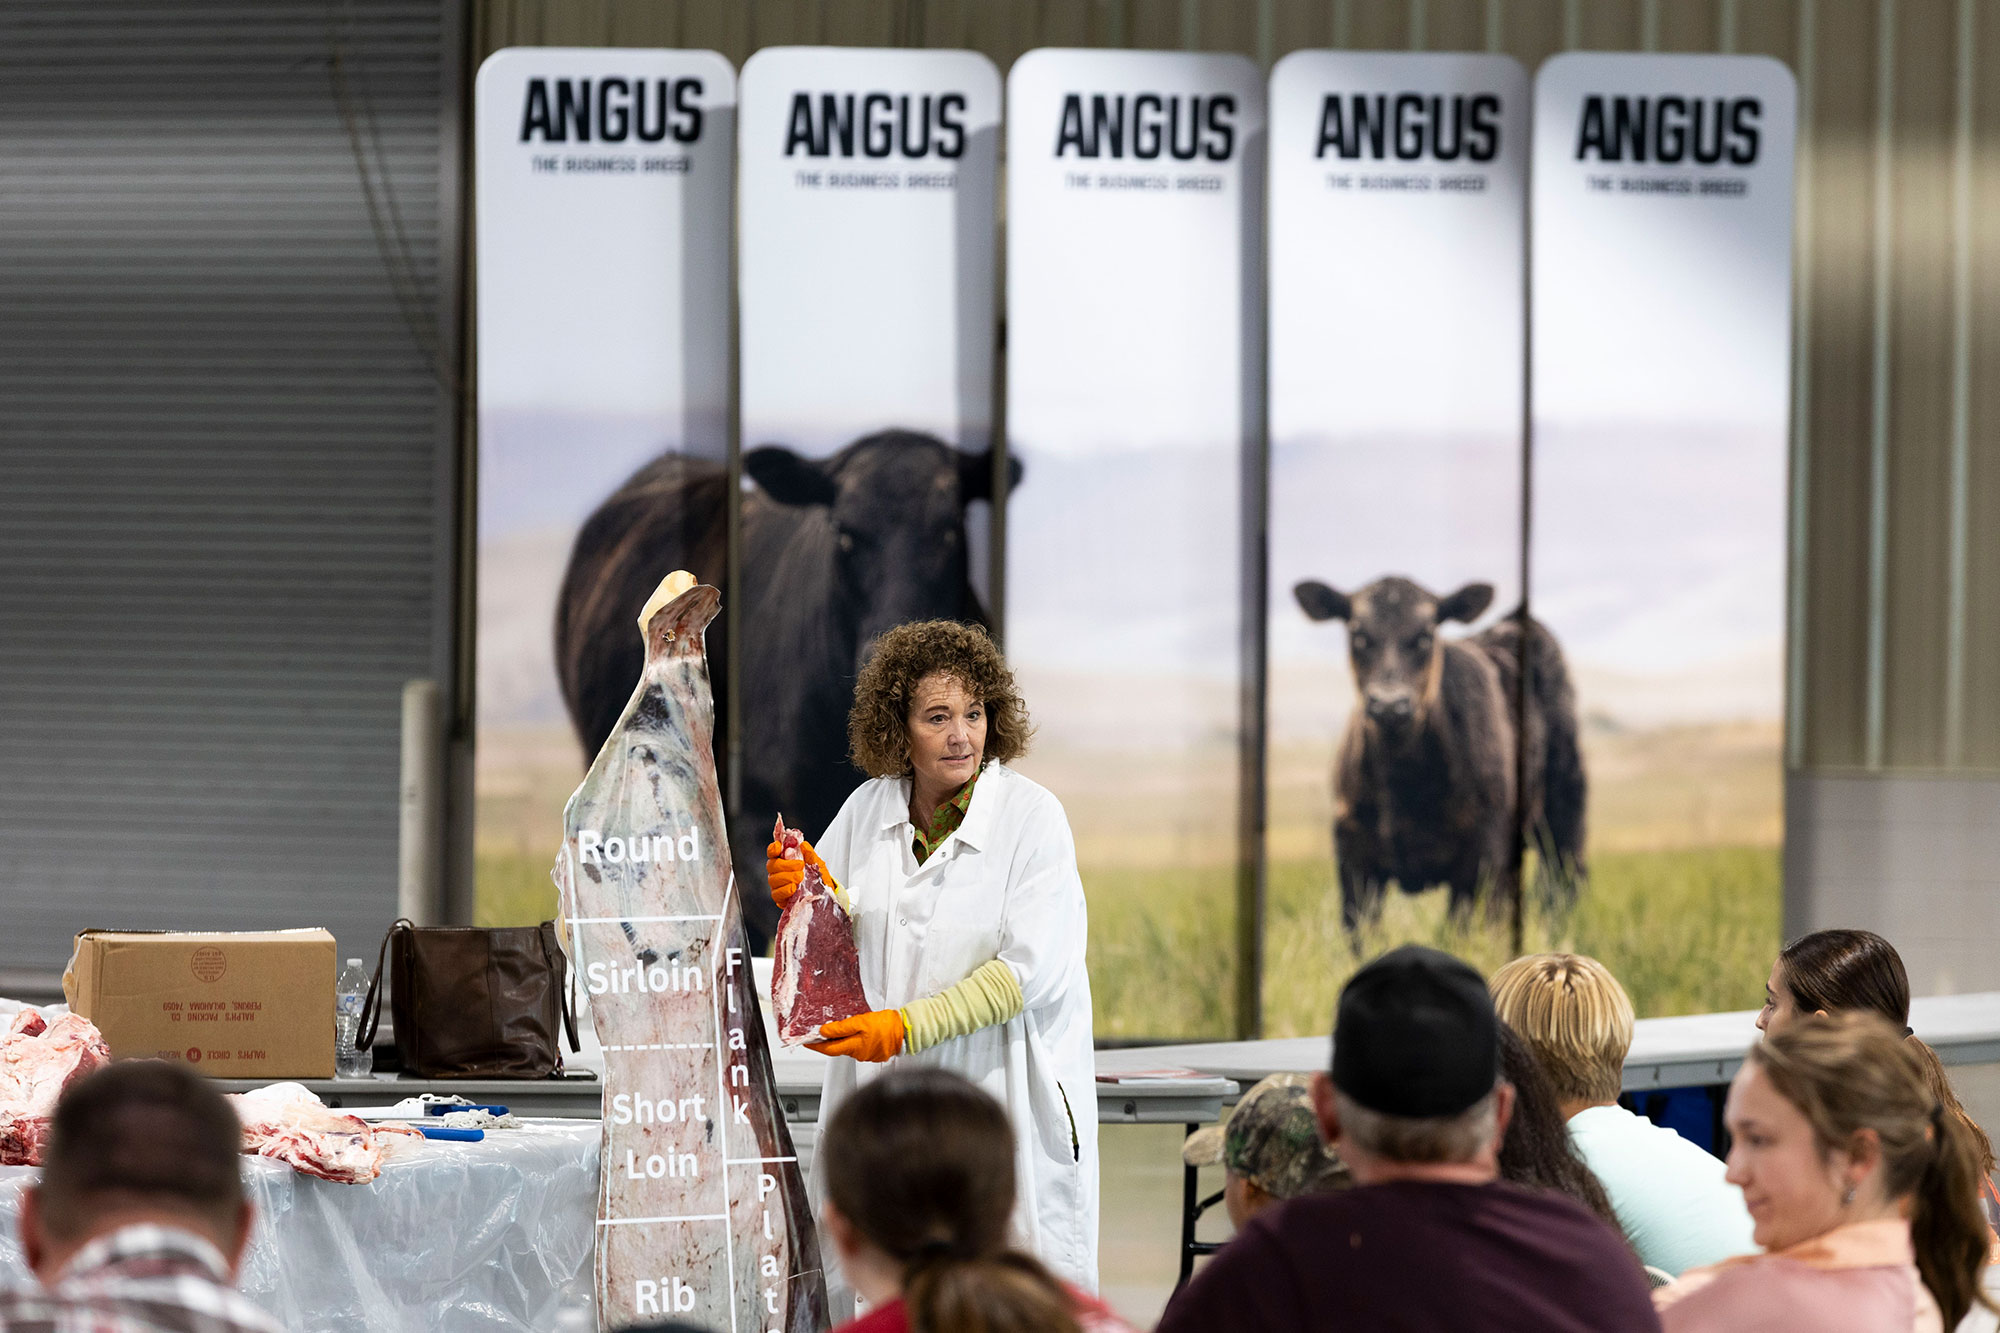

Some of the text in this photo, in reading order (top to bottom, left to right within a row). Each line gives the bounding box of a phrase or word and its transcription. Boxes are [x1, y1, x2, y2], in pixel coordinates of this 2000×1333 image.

[520, 78, 704, 142] ANGUS
[785, 93, 966, 158] ANGUS
[1056, 94, 1236, 161] ANGUS
[1316, 94, 1499, 161] ANGUS
[1576, 96, 1760, 164] ANGUS
[578, 826, 700, 863] Round
[587, 959, 703, 994] Sirloin
[187, 1012, 218, 1021] PACKING
[190, 1002, 226, 1011] OKLAHOMA
[225, 1012, 255, 1021] RALPH'S
[207, 1050, 231, 1059] CIRCLE
[726, 948, 751, 1125] Flank
[613, 1092, 707, 1125] Short
[626, 1146, 698, 1180] Loin
[757, 1173, 783, 1333] Plat
[635, 1276, 695, 1314] Rib
